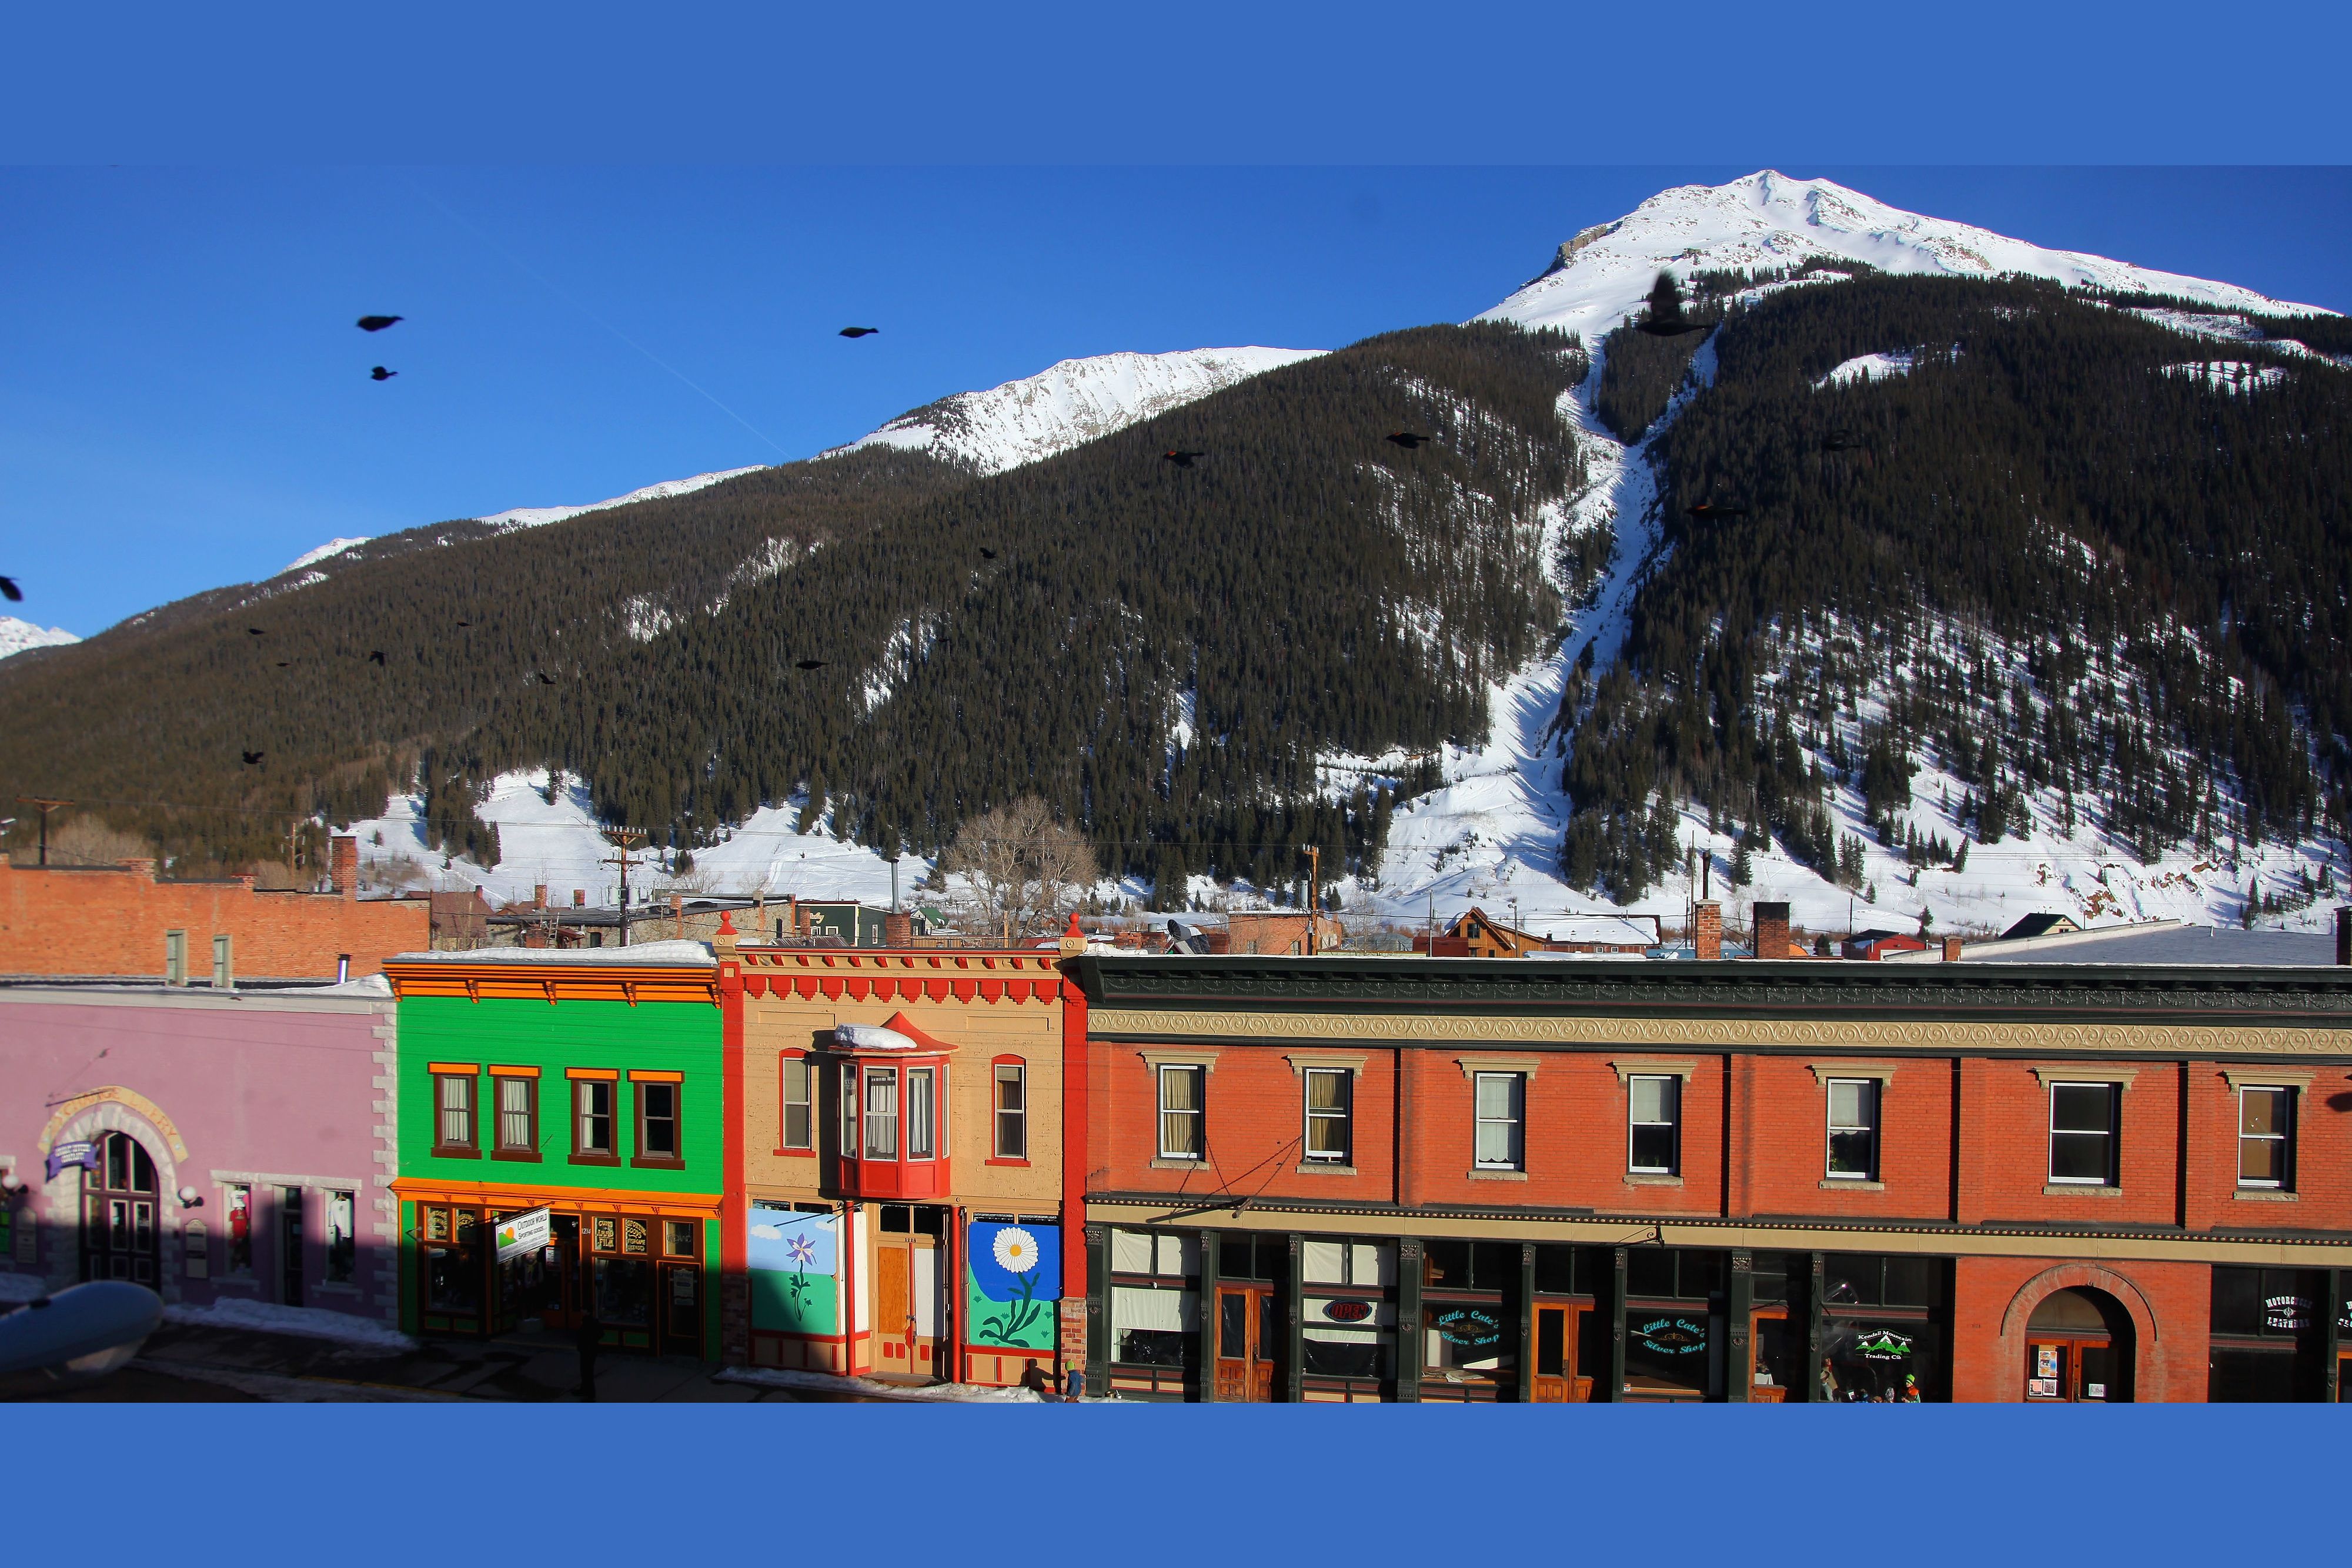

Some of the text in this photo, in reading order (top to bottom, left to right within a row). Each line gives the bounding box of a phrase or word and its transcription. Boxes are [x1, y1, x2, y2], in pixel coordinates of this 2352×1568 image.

[517, 1213, 547, 1231] OUTDOOR WORLD
[518, 1229, 533, 1239] SPORTING
[2265, 1296, 2313, 1309] MOTORCYCLE
[1331, 1303, 1368, 1319] OPEN
[1439, 1310, 1465, 1326] Little
[1643, 1319, 1671, 1335] Little
[2267, 1316, 2310, 1328] LEATHERS
[1439, 1331, 1499, 1345] Silver Shop
[1858, 1330, 1912, 1342] Kendall Mountain
[1643, 1340, 1706, 1354] Silver Shop
